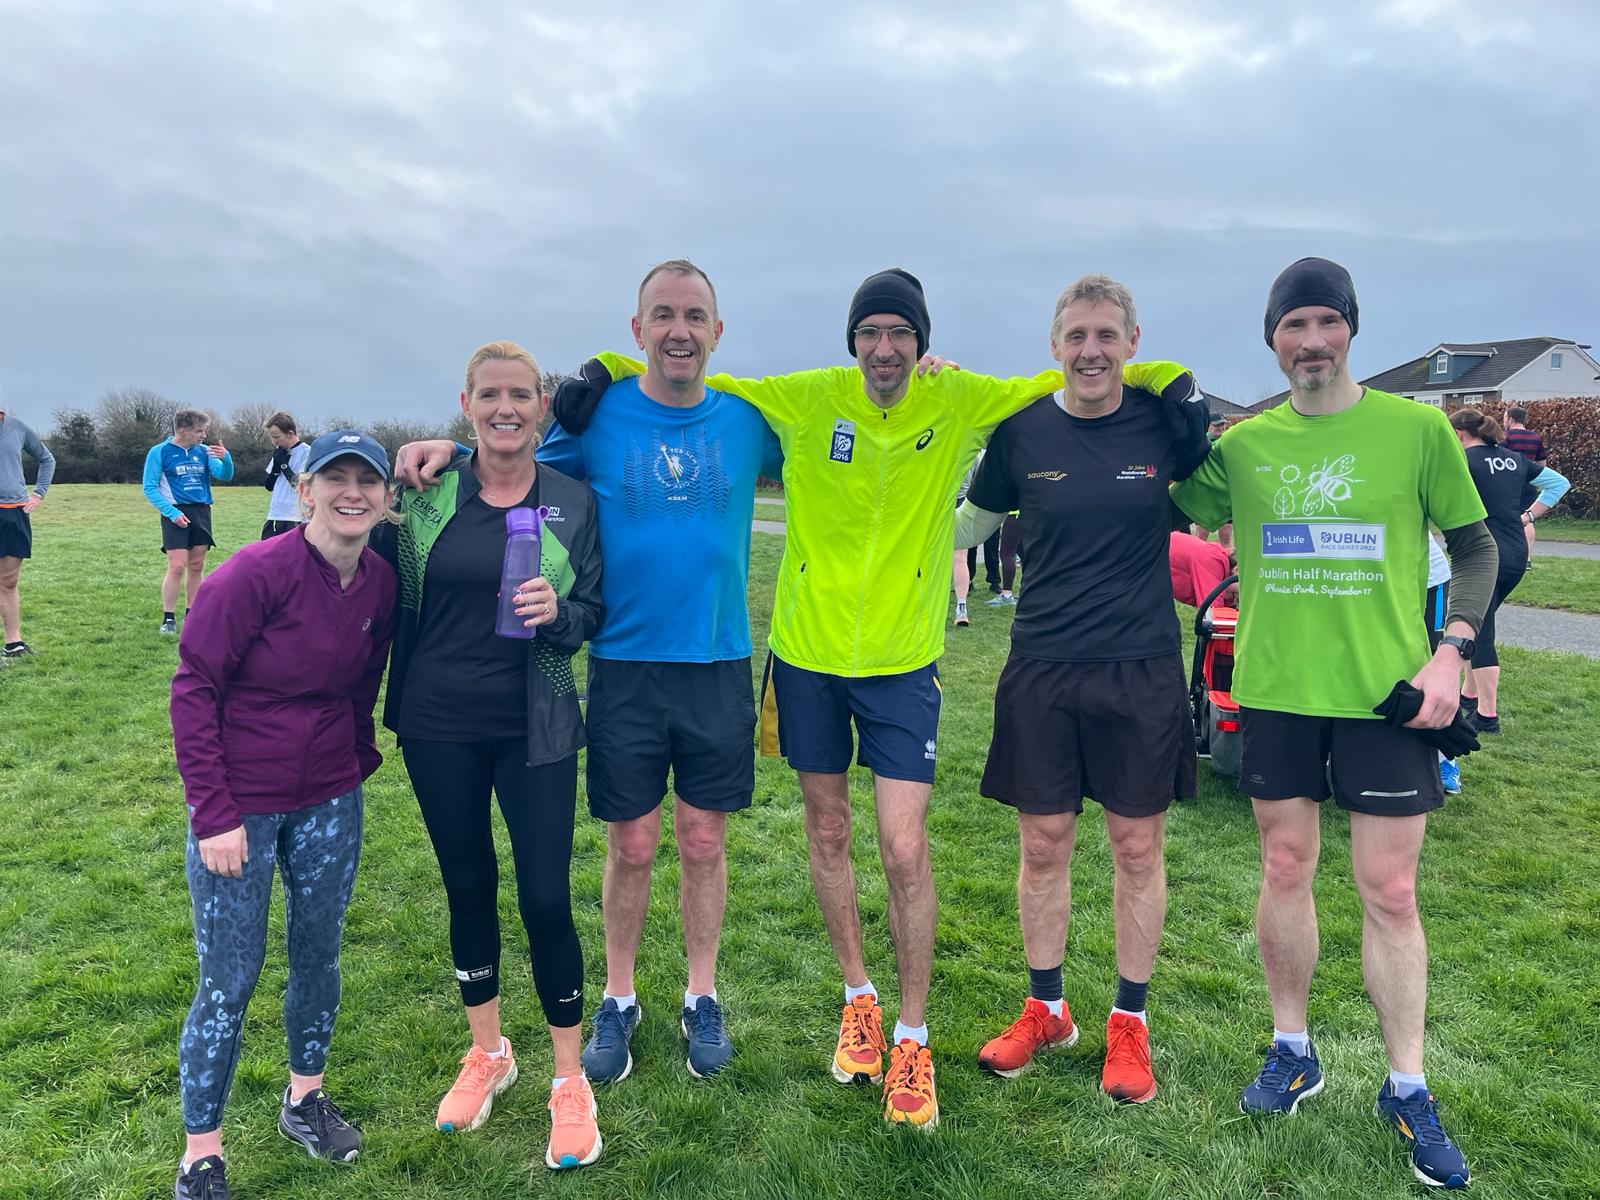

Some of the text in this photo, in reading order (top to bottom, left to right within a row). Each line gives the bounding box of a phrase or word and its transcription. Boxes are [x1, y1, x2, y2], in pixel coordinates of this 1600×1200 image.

[832, 452, 849, 461] 2016
[1484, 457, 1518, 475] 100
[1027, 471, 1060, 480] saucony
[412, 496, 438, 515] Esker
[1273, 534, 1305, 544] Irish Life
[1320, 531, 1377, 545] DUBLIN
[1293, 568, 1320, 581] Half
[1323, 569, 1384, 582] Marathon
[1321, 584, 1362, 599] September
